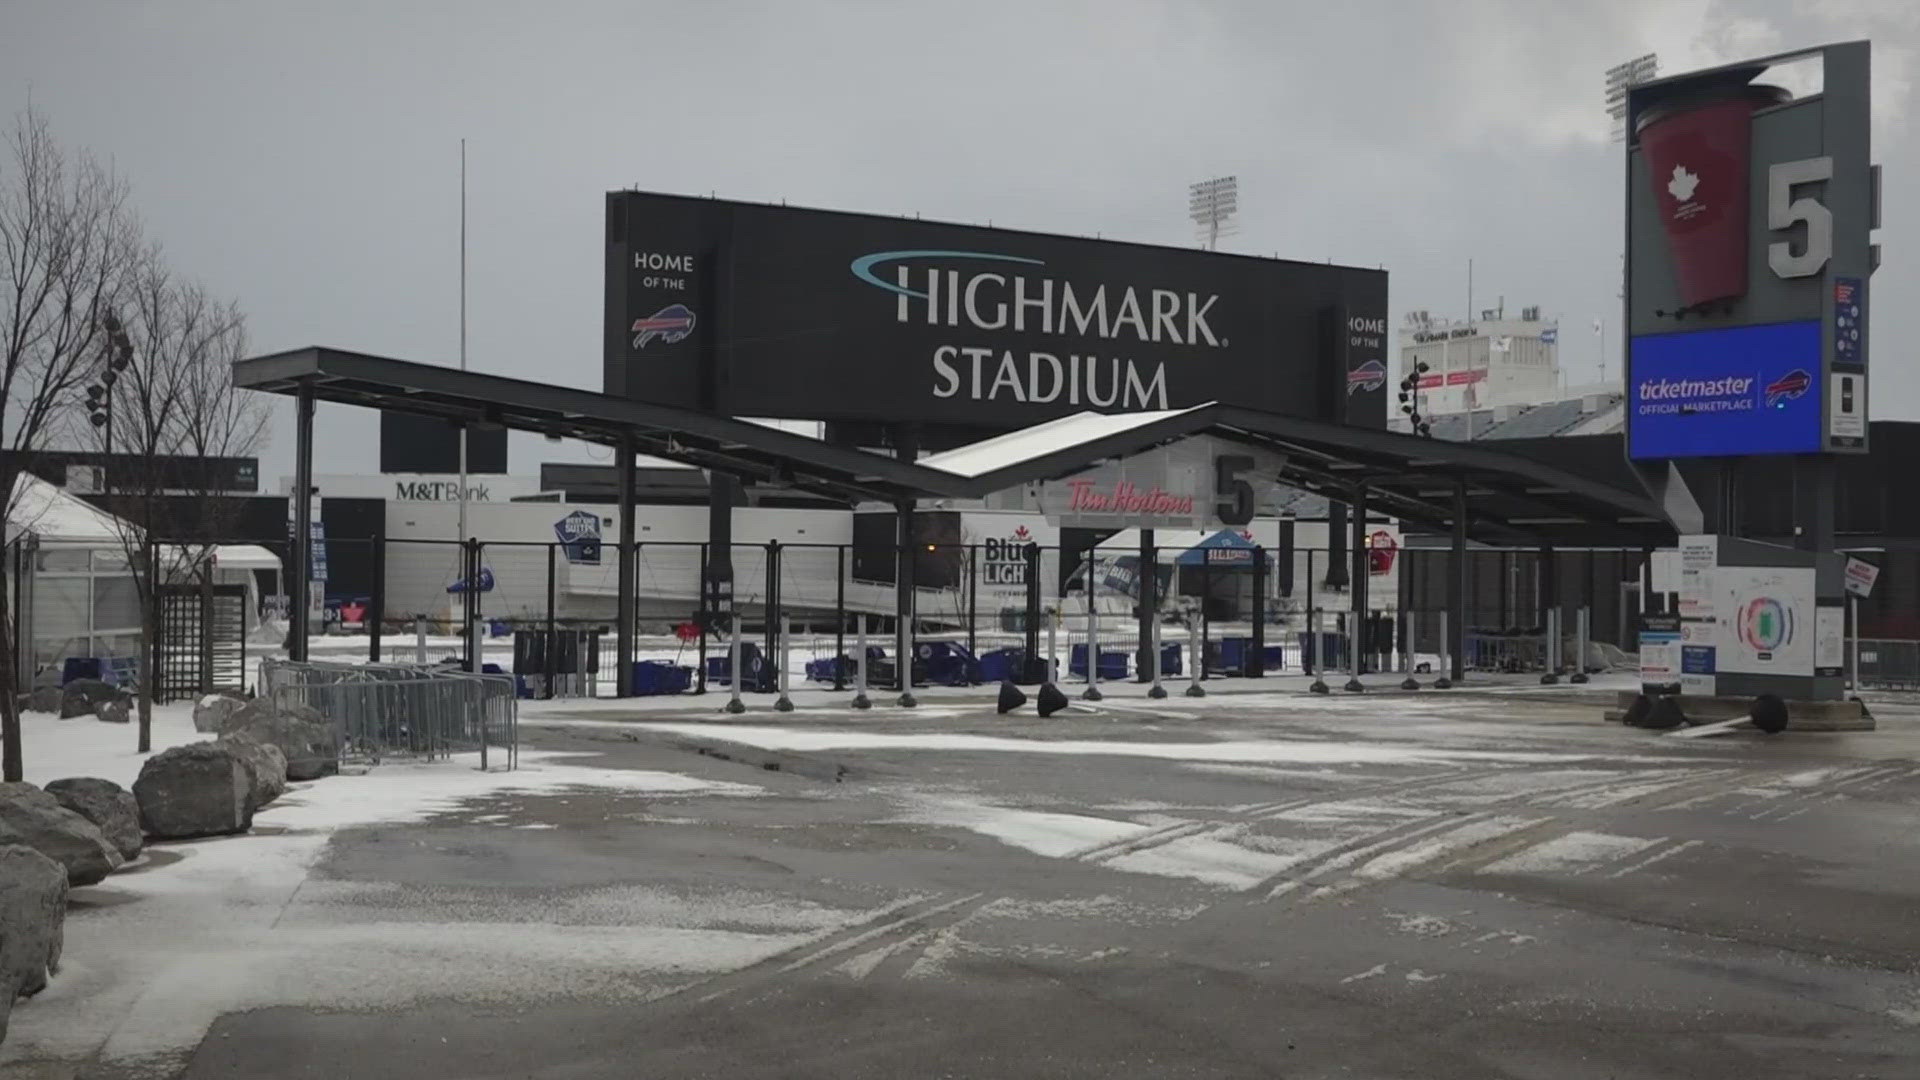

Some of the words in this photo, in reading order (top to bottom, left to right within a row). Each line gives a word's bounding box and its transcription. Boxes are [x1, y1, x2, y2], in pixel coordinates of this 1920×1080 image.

[1768, 156, 1833, 278] 5
[634, 251, 693, 272] HOME
[643, 276, 660, 288] OF
[662, 277, 685, 290] THE
[897, 265, 1220, 348] HIGHMARK
[1350, 336, 1362, 346] OF
[1363, 337, 1379, 349] THE
[933, 345, 1169, 411] STADIUM
[1640, 376, 1753, 400] ticketmaster
[1639, 403, 1680, 415] OFFICIAL
[1682, 398, 1753, 413] MARKETPLACE
[396, 481, 445, 501] M&T
[446, 482, 490, 501] Bnk
[1066, 480, 1110, 512] Tim
[1112, 480, 1194, 514] Hortons
[1216, 455, 1255, 525] 5
[984, 564, 1028, 584] LIGH
